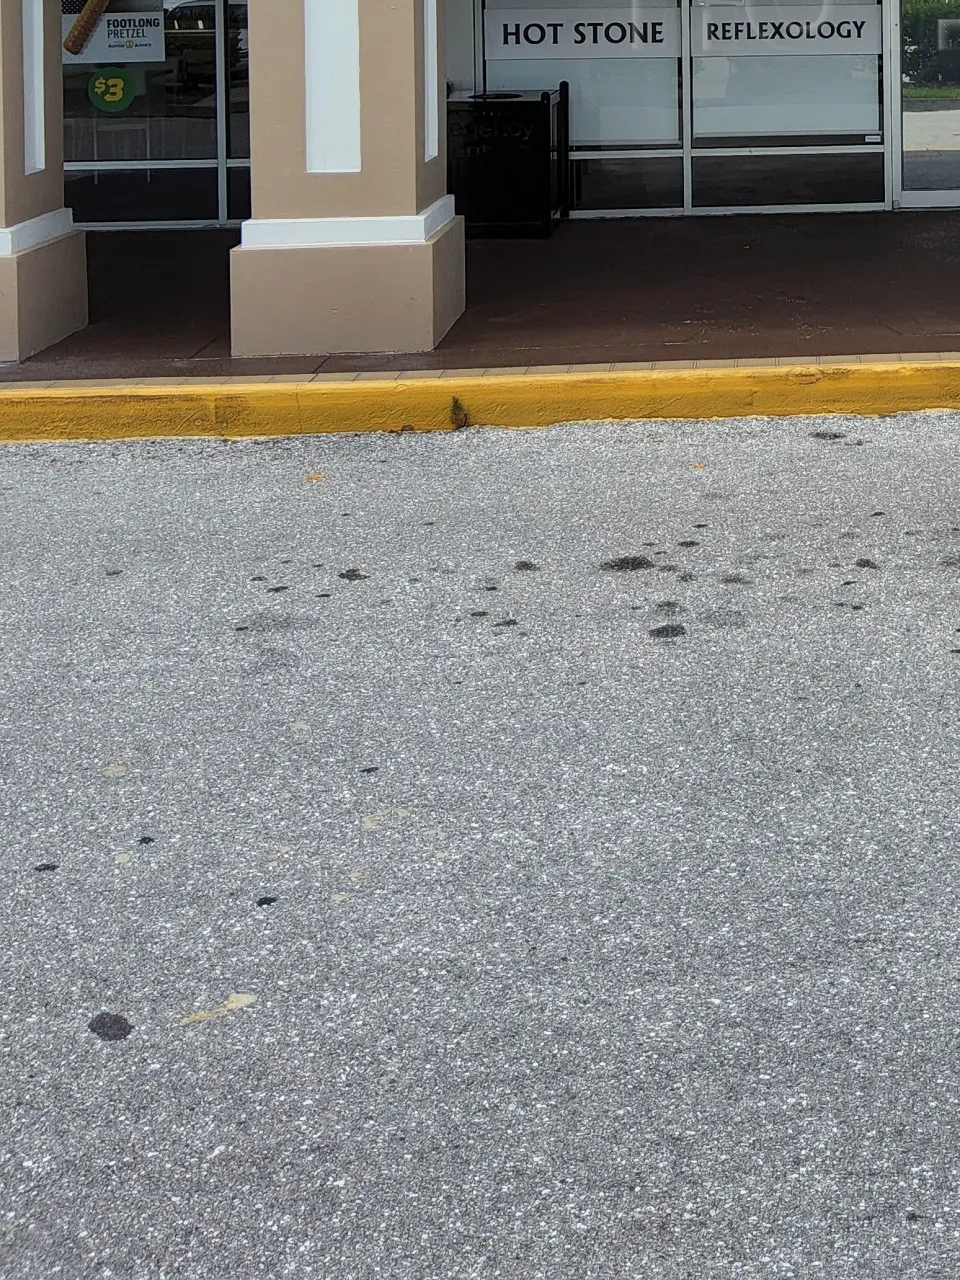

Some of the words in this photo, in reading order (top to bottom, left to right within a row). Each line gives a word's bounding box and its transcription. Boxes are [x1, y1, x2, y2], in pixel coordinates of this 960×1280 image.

[106, 18, 160, 29] FOOTLONG
[107, 28, 147, 39] PRETZEL
[502, 22, 564, 46] HOT
[573, 21, 665, 45] STONE
[707, 20, 868, 41] REFLEXOLOGY
[93, 76, 125, 102] $3
